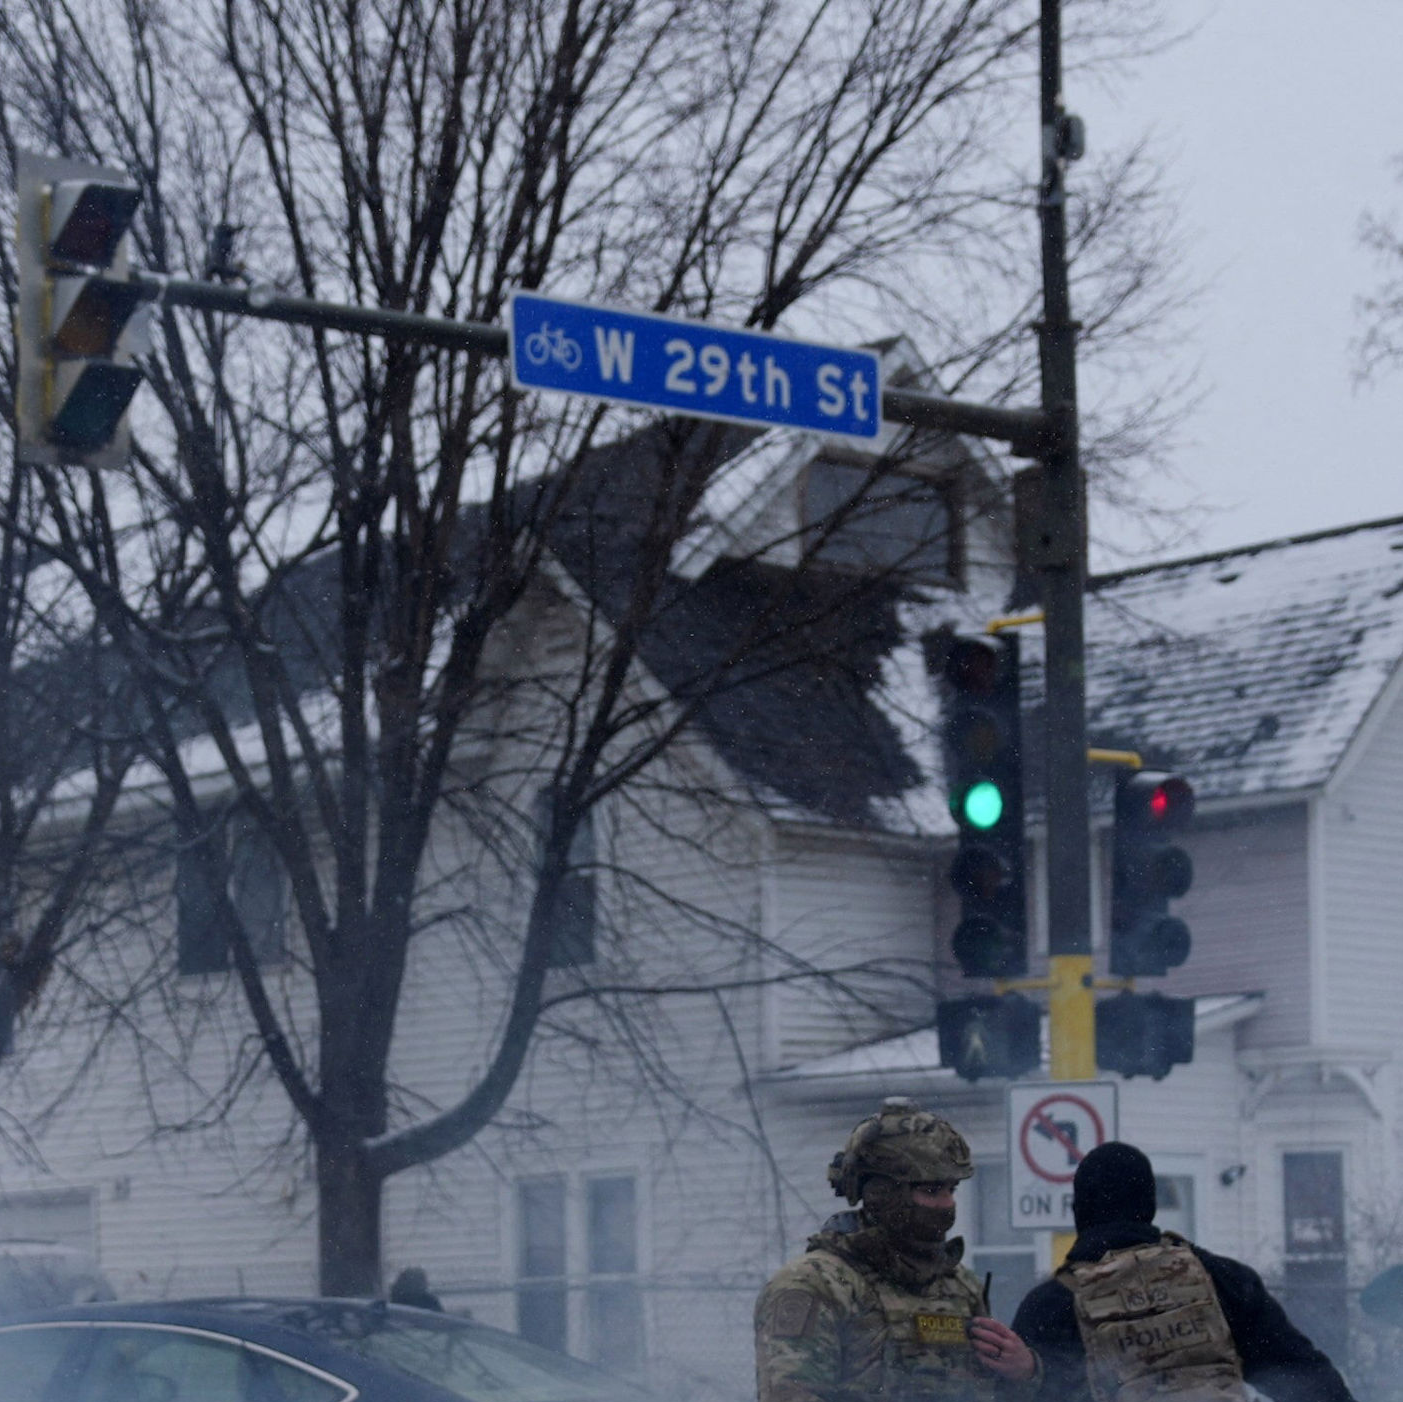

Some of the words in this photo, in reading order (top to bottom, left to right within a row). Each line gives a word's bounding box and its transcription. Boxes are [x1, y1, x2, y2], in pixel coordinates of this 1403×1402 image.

[594, 326, 636, 384] W
[664, 338, 792, 409] 29th
[816, 363, 870, 422] St
[1019, 1193, 1052, 1215] ON
[917, 1314, 964, 1331] POLICE
[1117, 1317, 1206, 1353] POLICE
